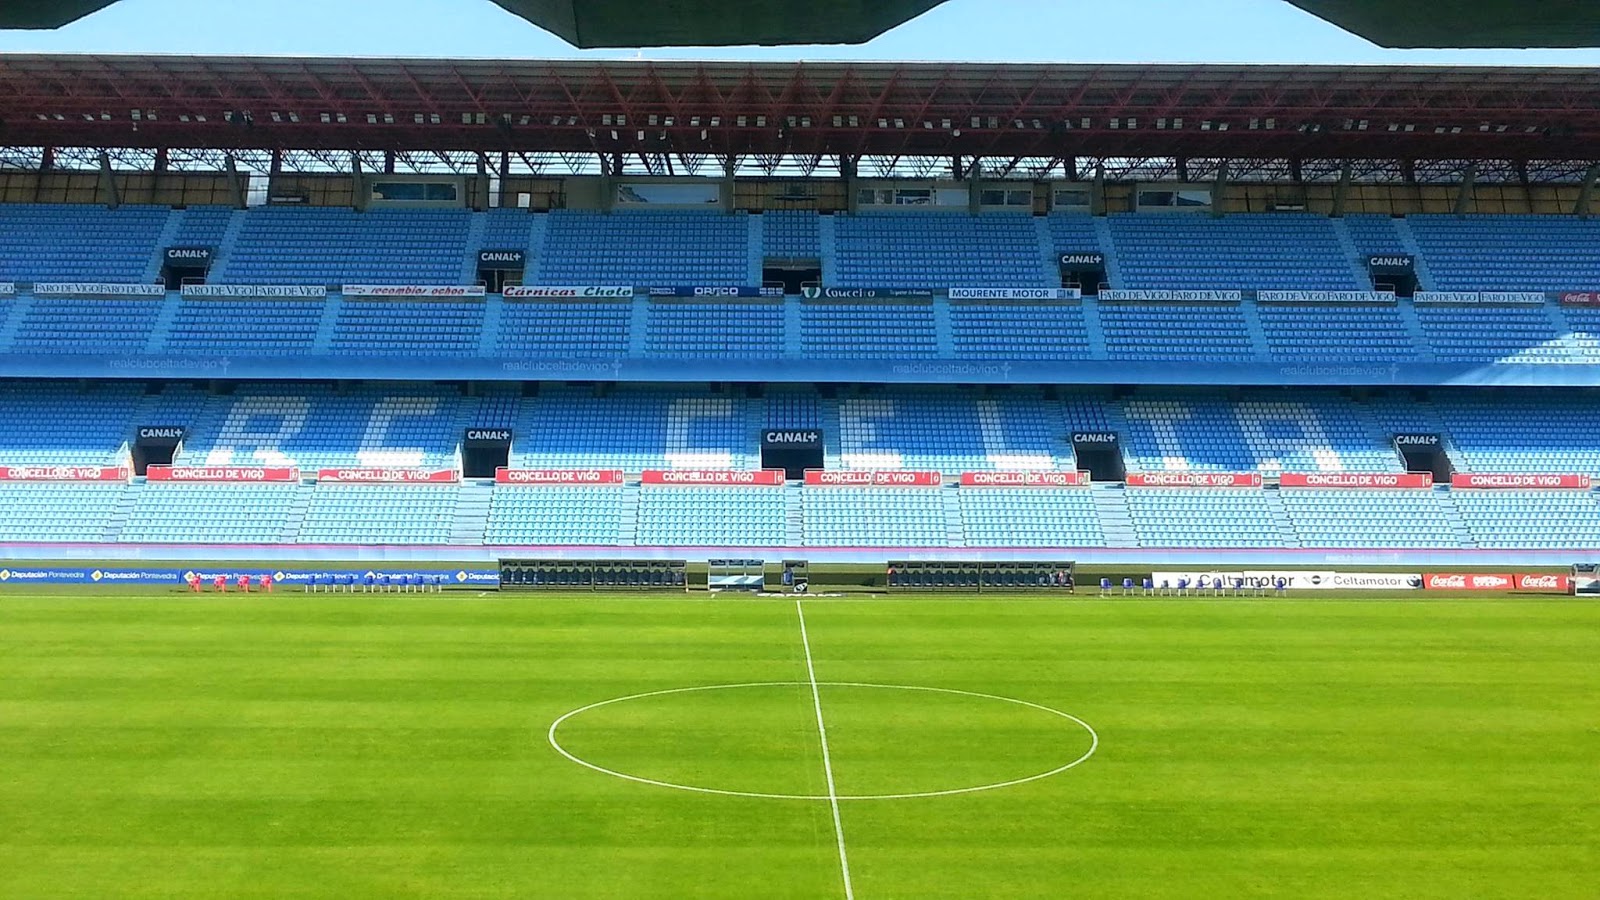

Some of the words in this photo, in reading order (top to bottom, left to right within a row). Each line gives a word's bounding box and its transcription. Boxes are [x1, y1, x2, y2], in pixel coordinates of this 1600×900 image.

[168, 250, 208, 258] CANAL+
[481, 252, 521, 261] CANAL+
[1062, 255, 1102, 264] CANAL+
[1370, 257, 1410, 266] CANAL+
[504, 287, 576, 296] Cárnicas
[584, 287, 632, 296] Cholo
[952, 290, 1008, 298] MOURENTE
[1012, 290, 1049, 298] MOTOR
[140, 428, 182, 438] CANAL+
[468, 430, 510, 440] CANAL+
[766, 432, 818, 442] CANAL+
[1074, 434, 1116, 442] CANAL+
[1396, 436, 1438, 444] CANAL+
[8, 469, 60, 478] CONCELLO
[62, 469, 75, 478] DE
[78, 469, 101, 478] VIGO
[172, 470, 223, 478] CONCELLO
[226, 470, 238, 478] DE
[241, 470, 264, 478] VIGO
[338, 471, 390, 479] CONCELLO
[392, 471, 404, 479] DE
[407, 471, 430, 479] VIGO
[508, 472, 560, 480] CONCELLO
[561, 472, 574, 480] DE
[576, 472, 600, 480] VIGO
[663, 472, 713, 481] CONCELLO
[716, 472, 728, 481] DE
[730, 472, 754, 481] VIGO
[820, 473, 871, 482] CONCELLO
[877, 473, 890, 482] DE
[892, 473, 915, 482] VIGO
[974, 474, 1024, 482] CONCELLO
[1028, 474, 1041, 482] DE
[1043, 474, 1066, 482] VIGO
[1144, 475, 1193, 483] CONCELLO
[1196, 475, 1208, 483] DE
[1211, 475, 1234, 483] VIGO
[1307, 476, 1358, 484] CONCELLO
[1359, 476, 1372, 484] DE
[1374, 476, 1397, 484] VIGO
[1471, 476, 1520, 485] CONCELLO
[1523, 476, 1536, 485] DE
[1538, 476, 1561, 485] VIGO
[1334, 576, 1401, 586] Celtamotor
